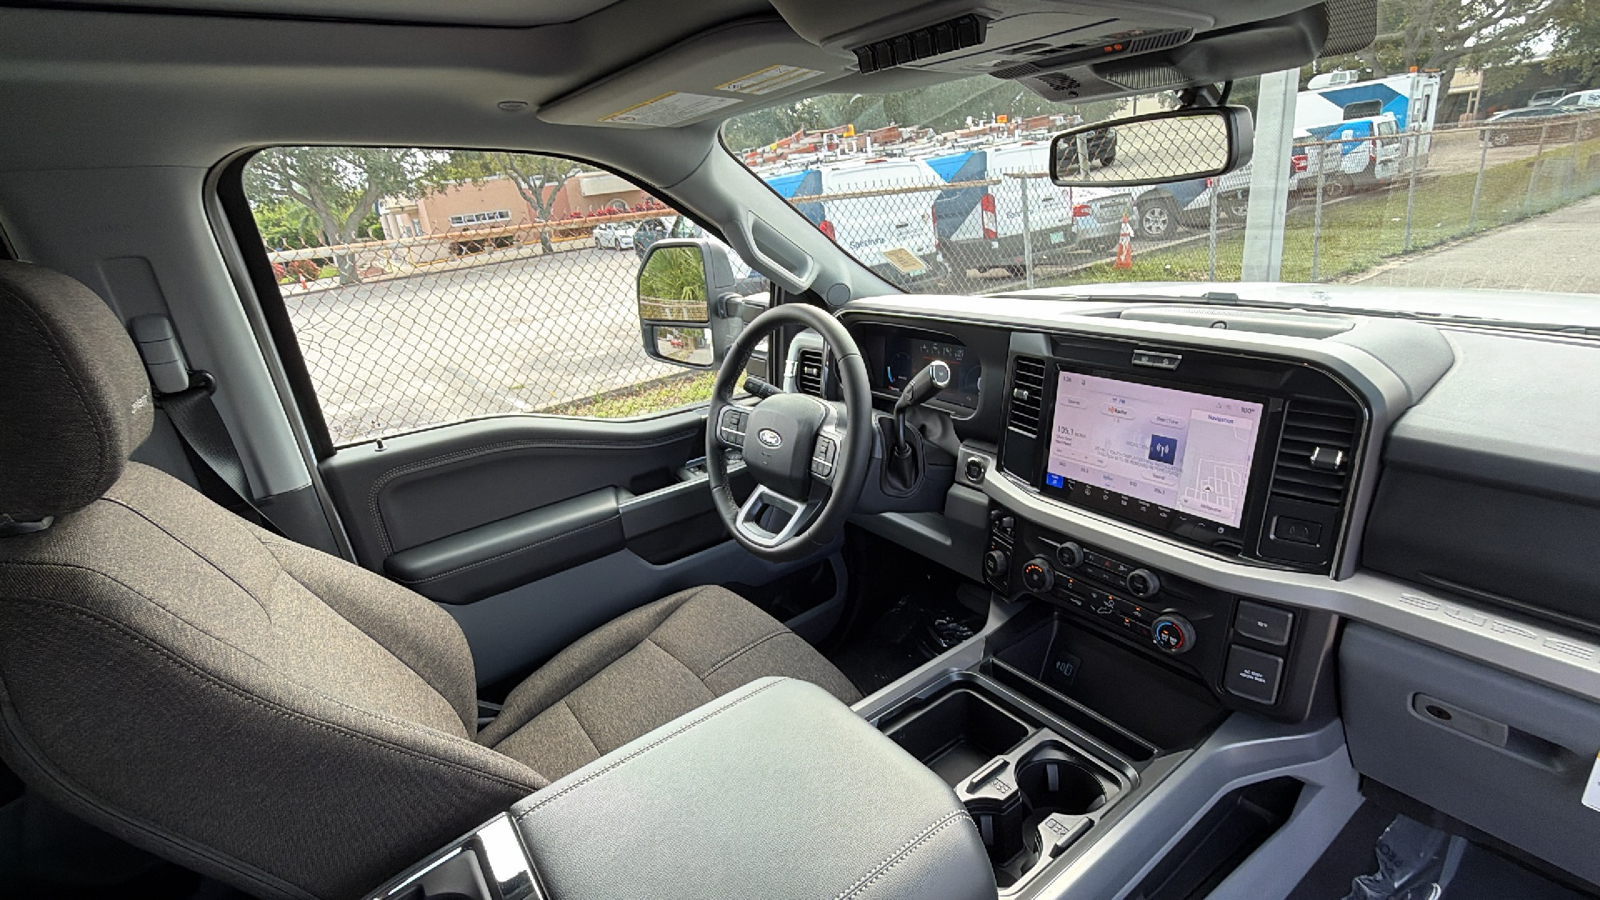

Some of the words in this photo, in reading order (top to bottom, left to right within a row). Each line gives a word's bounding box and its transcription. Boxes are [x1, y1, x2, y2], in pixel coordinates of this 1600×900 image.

[1207, 414, 1234, 425] Navigation
[1057, 425, 1073, 435] 105.1
[1399, 593, 1600, 662] SUPE
